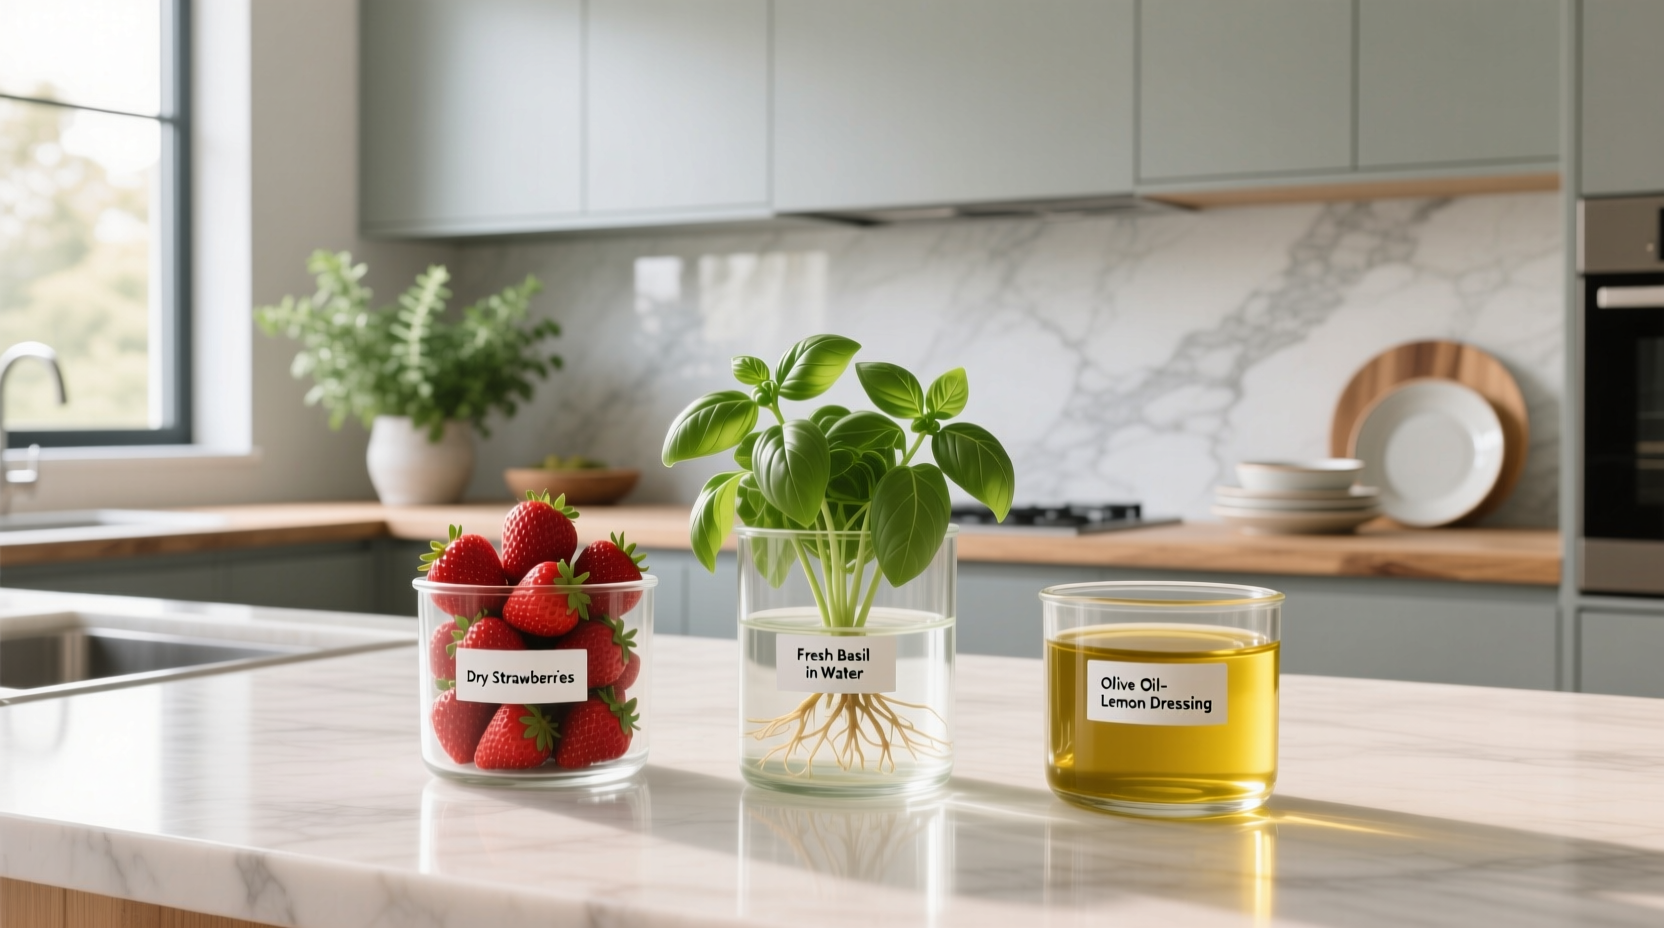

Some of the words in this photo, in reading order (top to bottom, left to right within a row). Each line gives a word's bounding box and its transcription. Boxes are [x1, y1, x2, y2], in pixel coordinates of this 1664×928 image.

[797, 647, 833, 662] Fresh
[837, 647, 870, 662] Basil
[466, 669, 489, 687] Dry
[492, 669, 575, 684] Strawberries
[805, 665, 818, 679] in
[820, 666, 864, 680] Water
[1100, 676, 1136, 691] Olive
[1101, 694, 1146, 709] Lemon
[1150, 695, 1213, 714] Dressing
